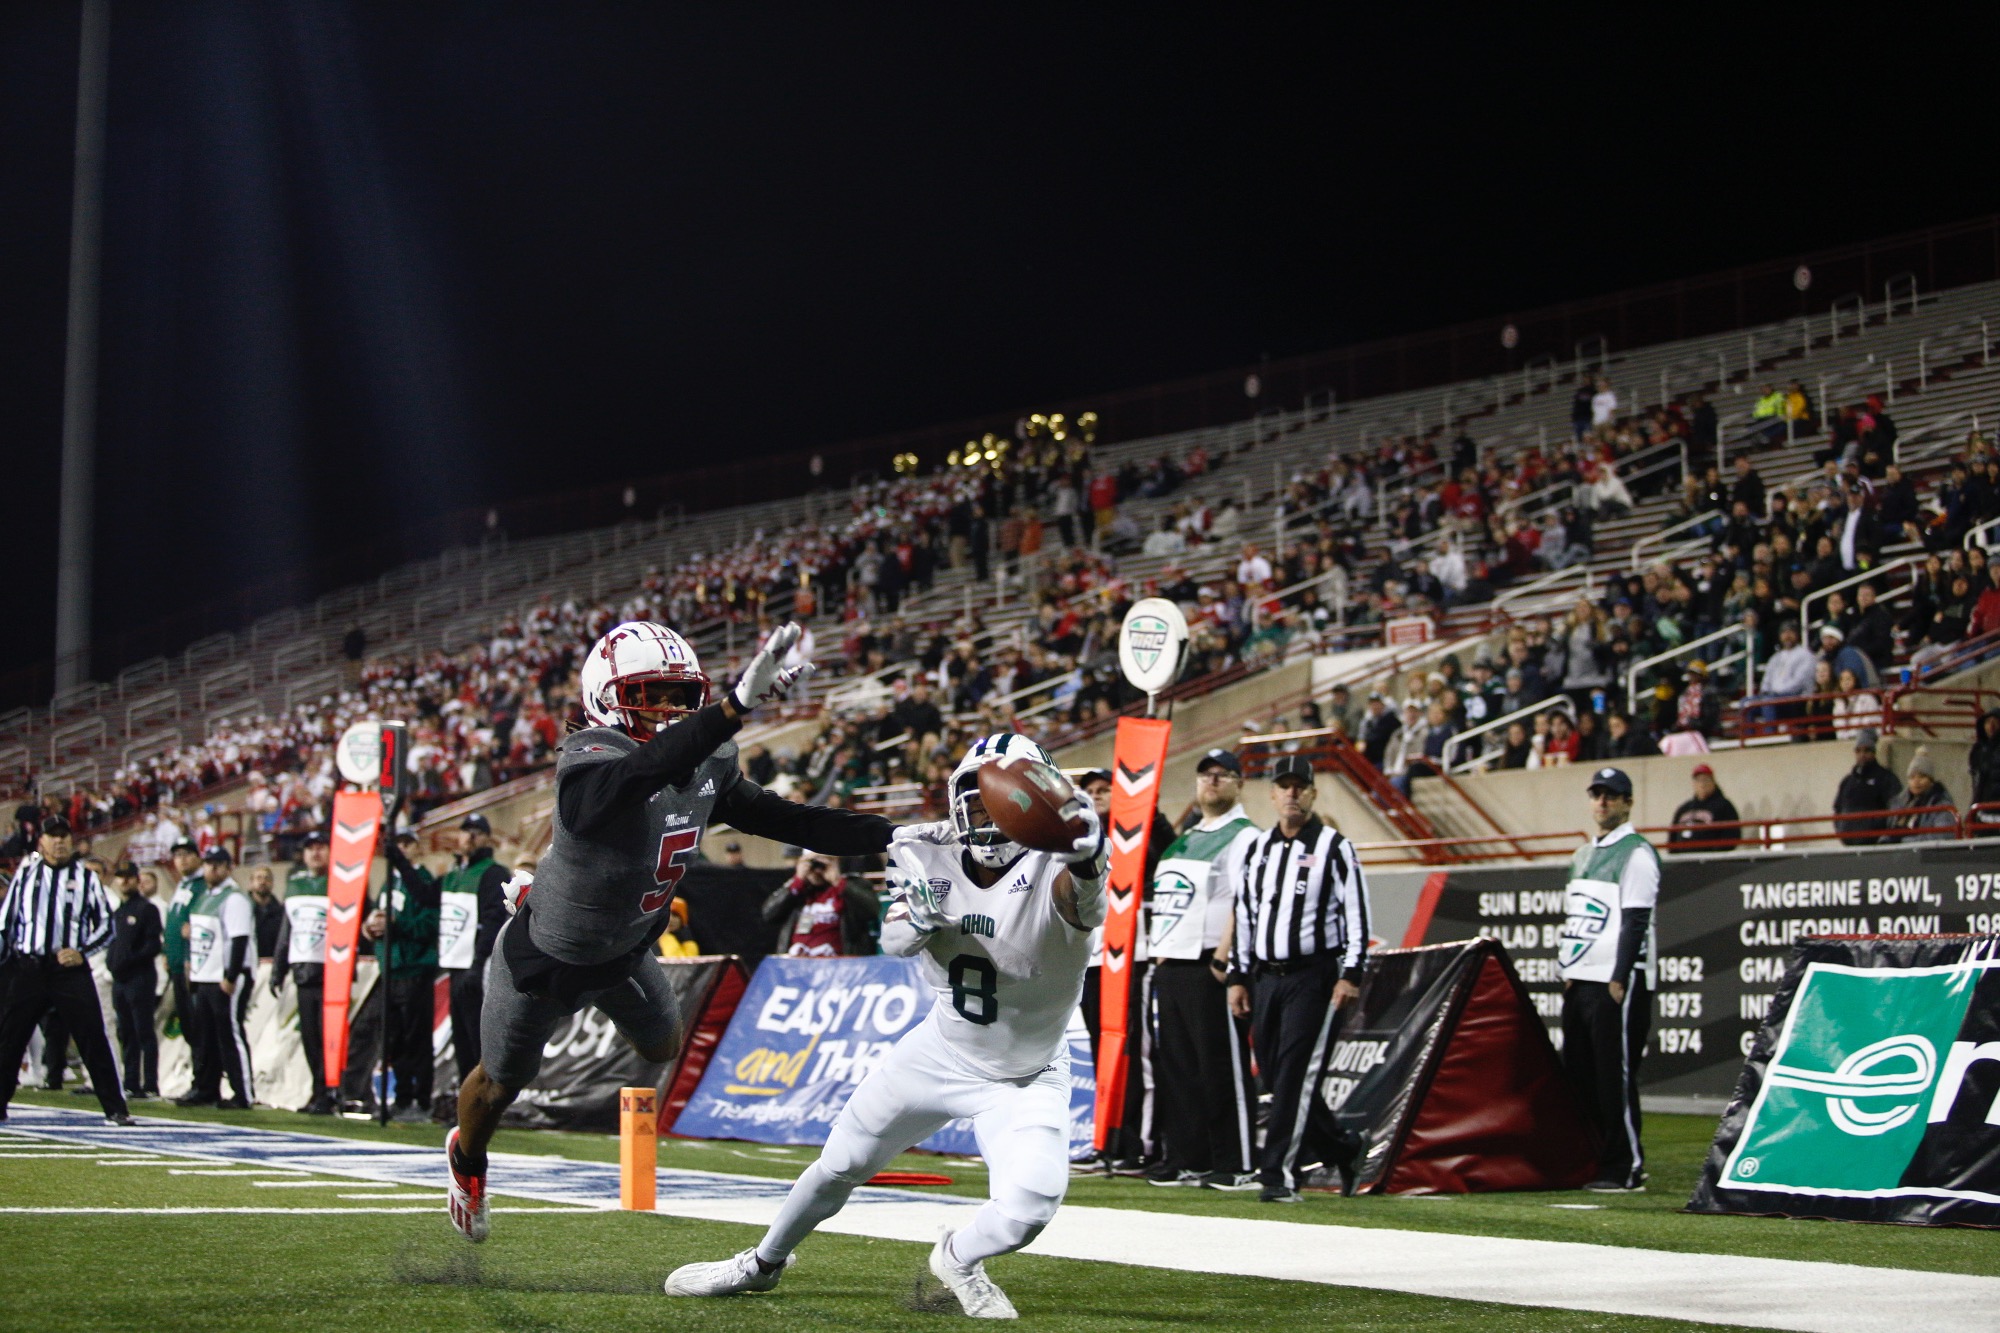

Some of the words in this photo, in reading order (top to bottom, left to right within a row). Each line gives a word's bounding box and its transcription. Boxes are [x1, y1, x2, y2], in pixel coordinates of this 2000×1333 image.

[639, 826, 700, 914] 5
[1007, 884, 1033, 895] adidas
[1295, 880, 1308, 895] S
[1739, 878, 1861, 909] TANGERINE
[1866, 875, 1943, 907] BOWL,
[1478, 890, 1517, 917] SUN
[960, 914, 995, 939] OHIO
[1657, 956, 1705, 982] 1962
[948, 953, 999, 1026] 8
[756, 984, 863, 1036] EASY
[852, 983, 918, 1036] TO
[1657, 991, 1703, 1018] 1973
[1657, 1027, 1703, 1054] 1974
[735, 1033, 821, 1088] and
